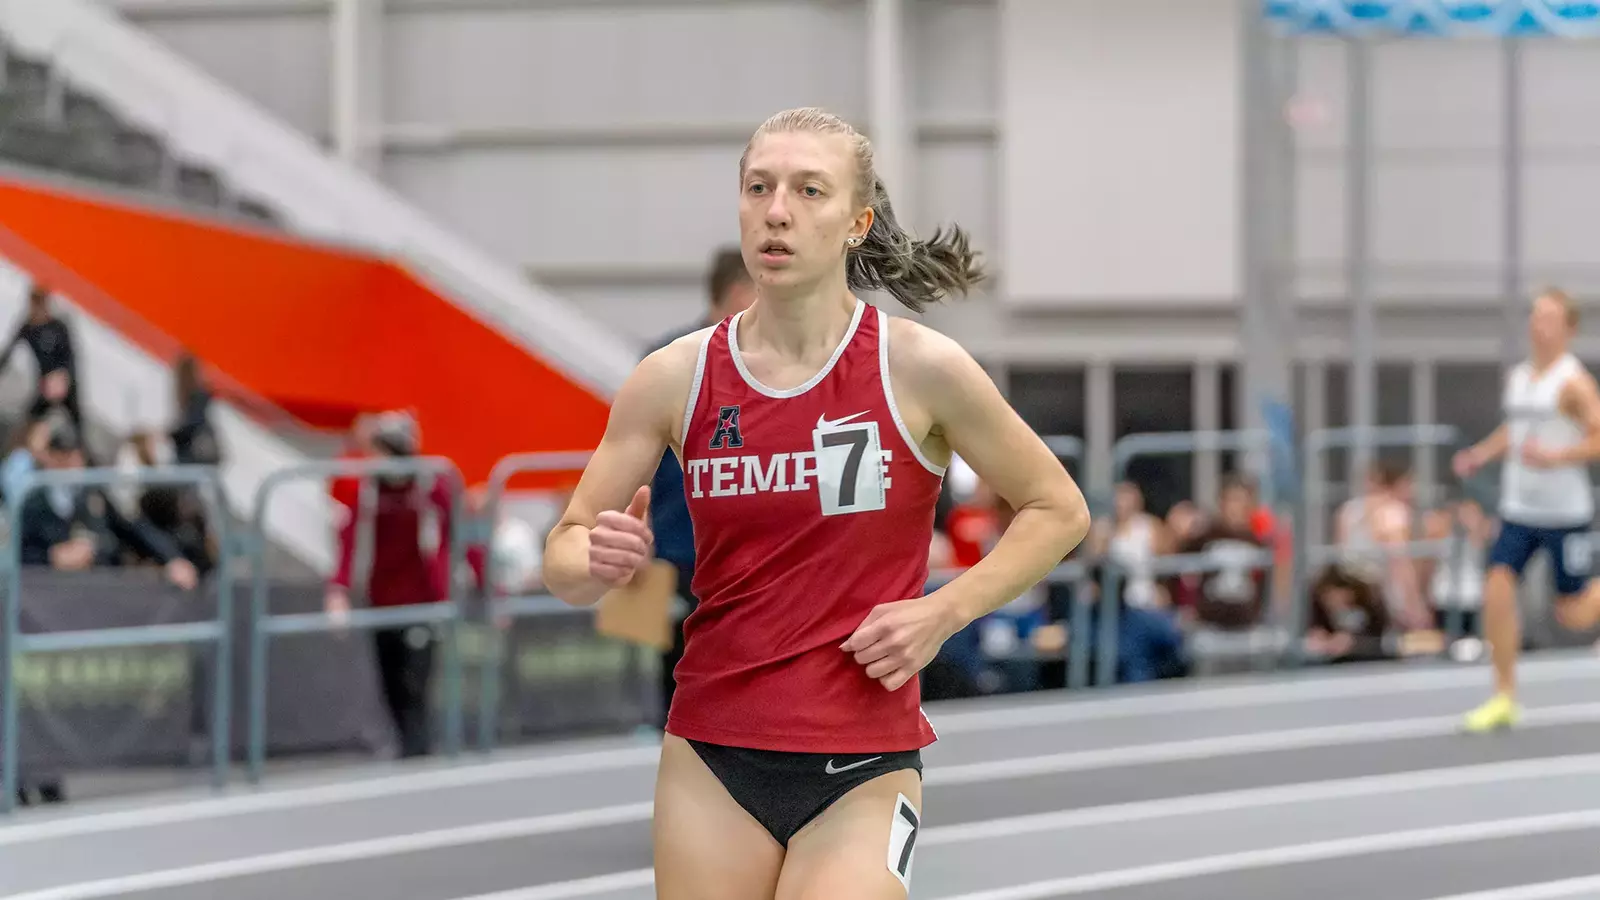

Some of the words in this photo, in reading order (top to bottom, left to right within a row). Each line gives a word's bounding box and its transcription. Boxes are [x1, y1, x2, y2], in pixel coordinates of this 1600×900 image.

[688, 450, 893, 499] TEMP
[821, 428, 869, 507] 7
[897, 801, 919, 877] 7
